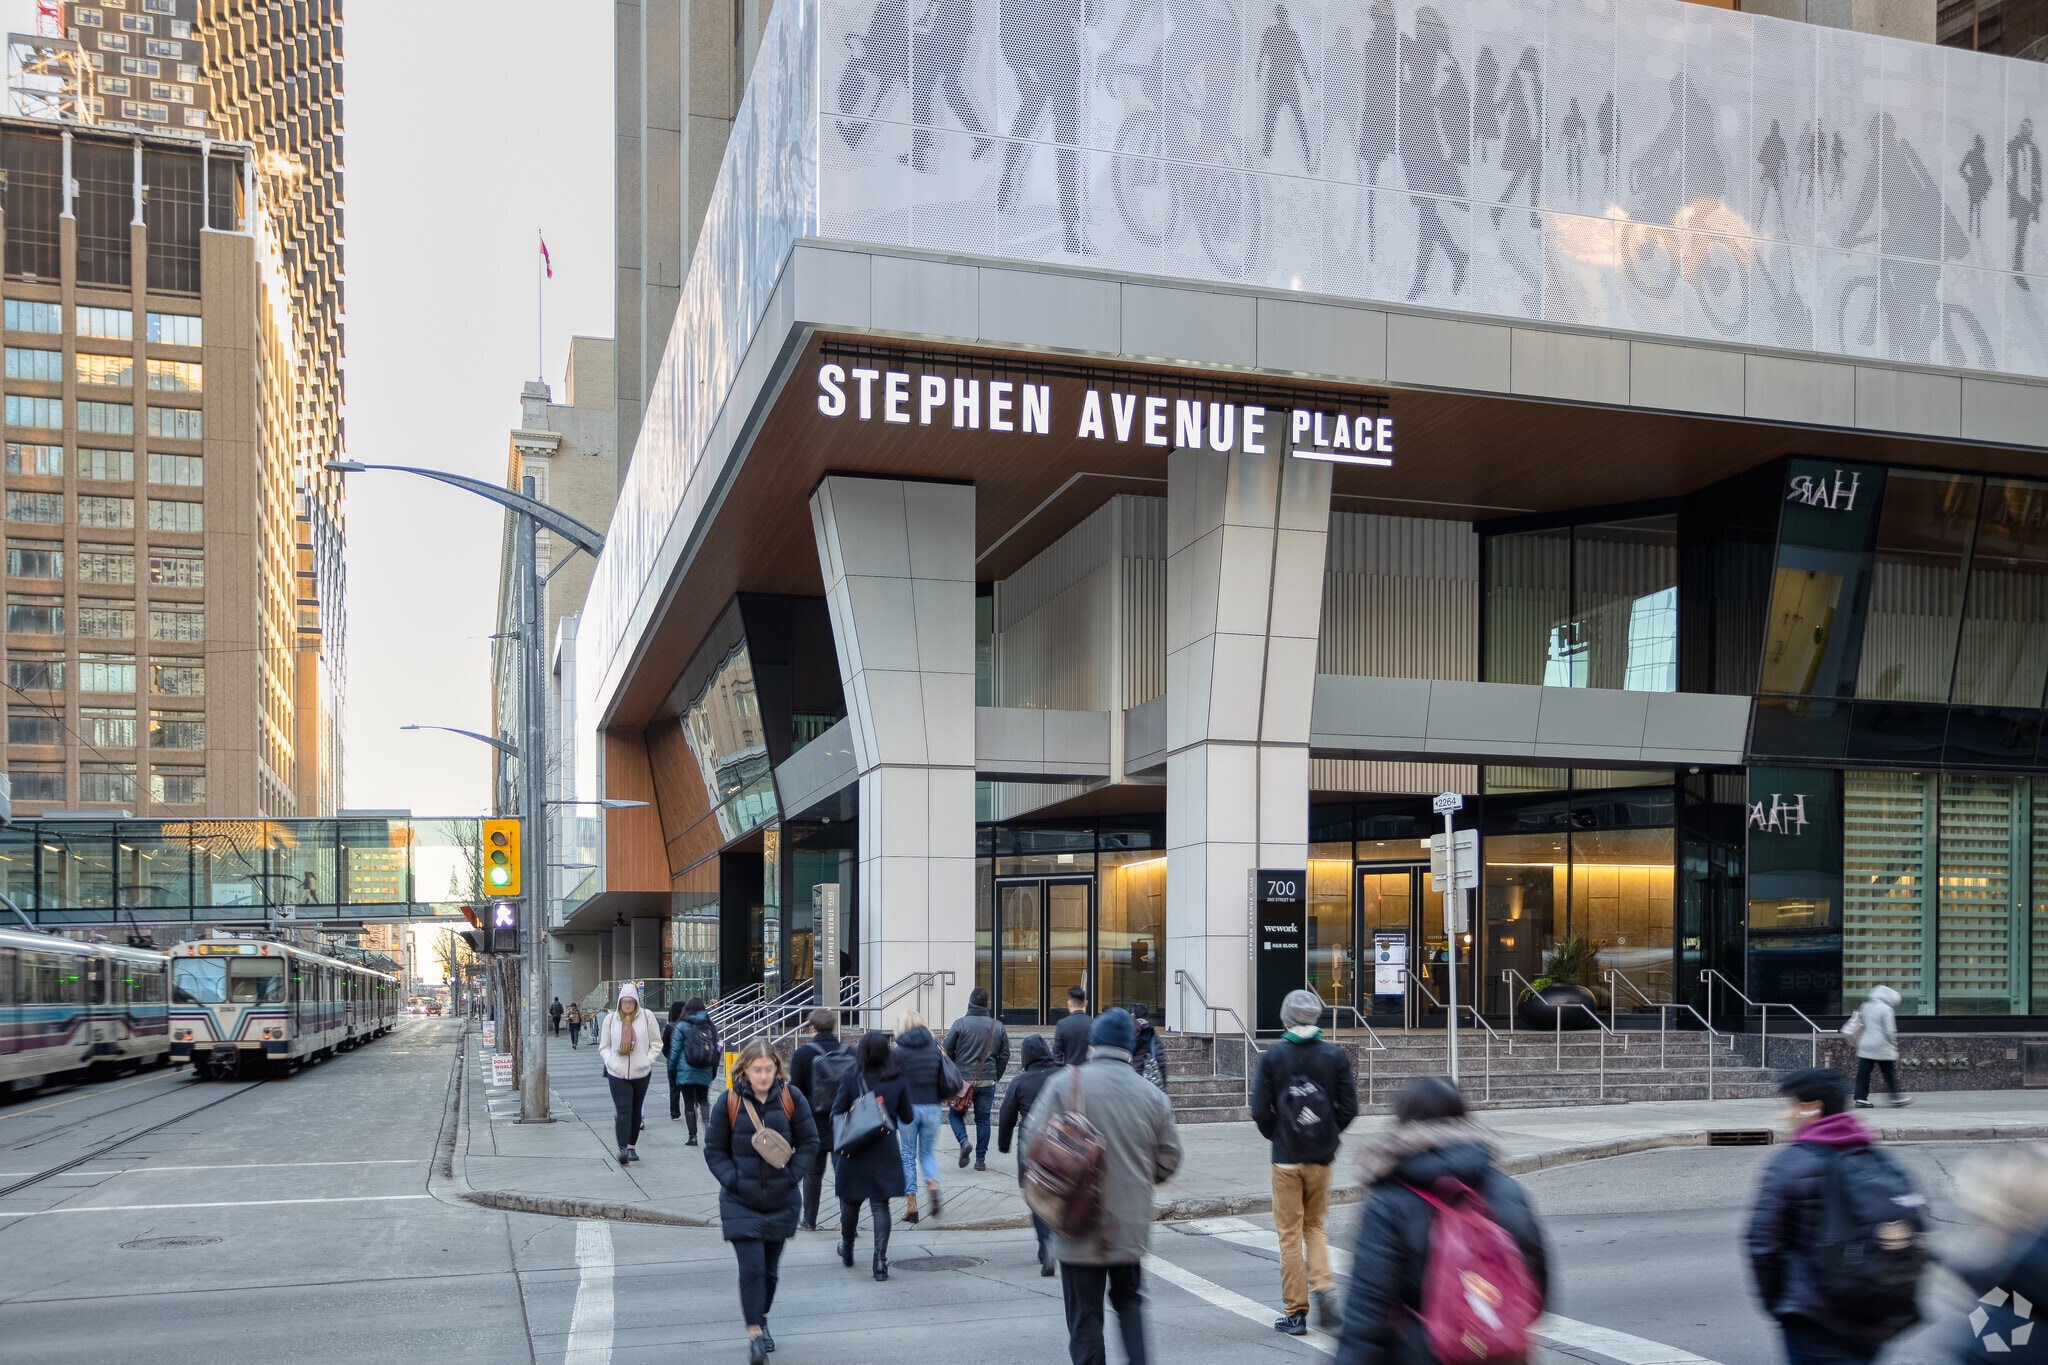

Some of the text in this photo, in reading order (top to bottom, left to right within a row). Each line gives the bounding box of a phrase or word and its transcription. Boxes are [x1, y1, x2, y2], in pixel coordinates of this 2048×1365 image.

[817, 362, 1394, 454] STEPHEN AVENUE PLACE
[1438, 797, 1457, 808] 2264
[1267, 880, 1296, 896] 700
[1264, 923, 1298, 933] wework
